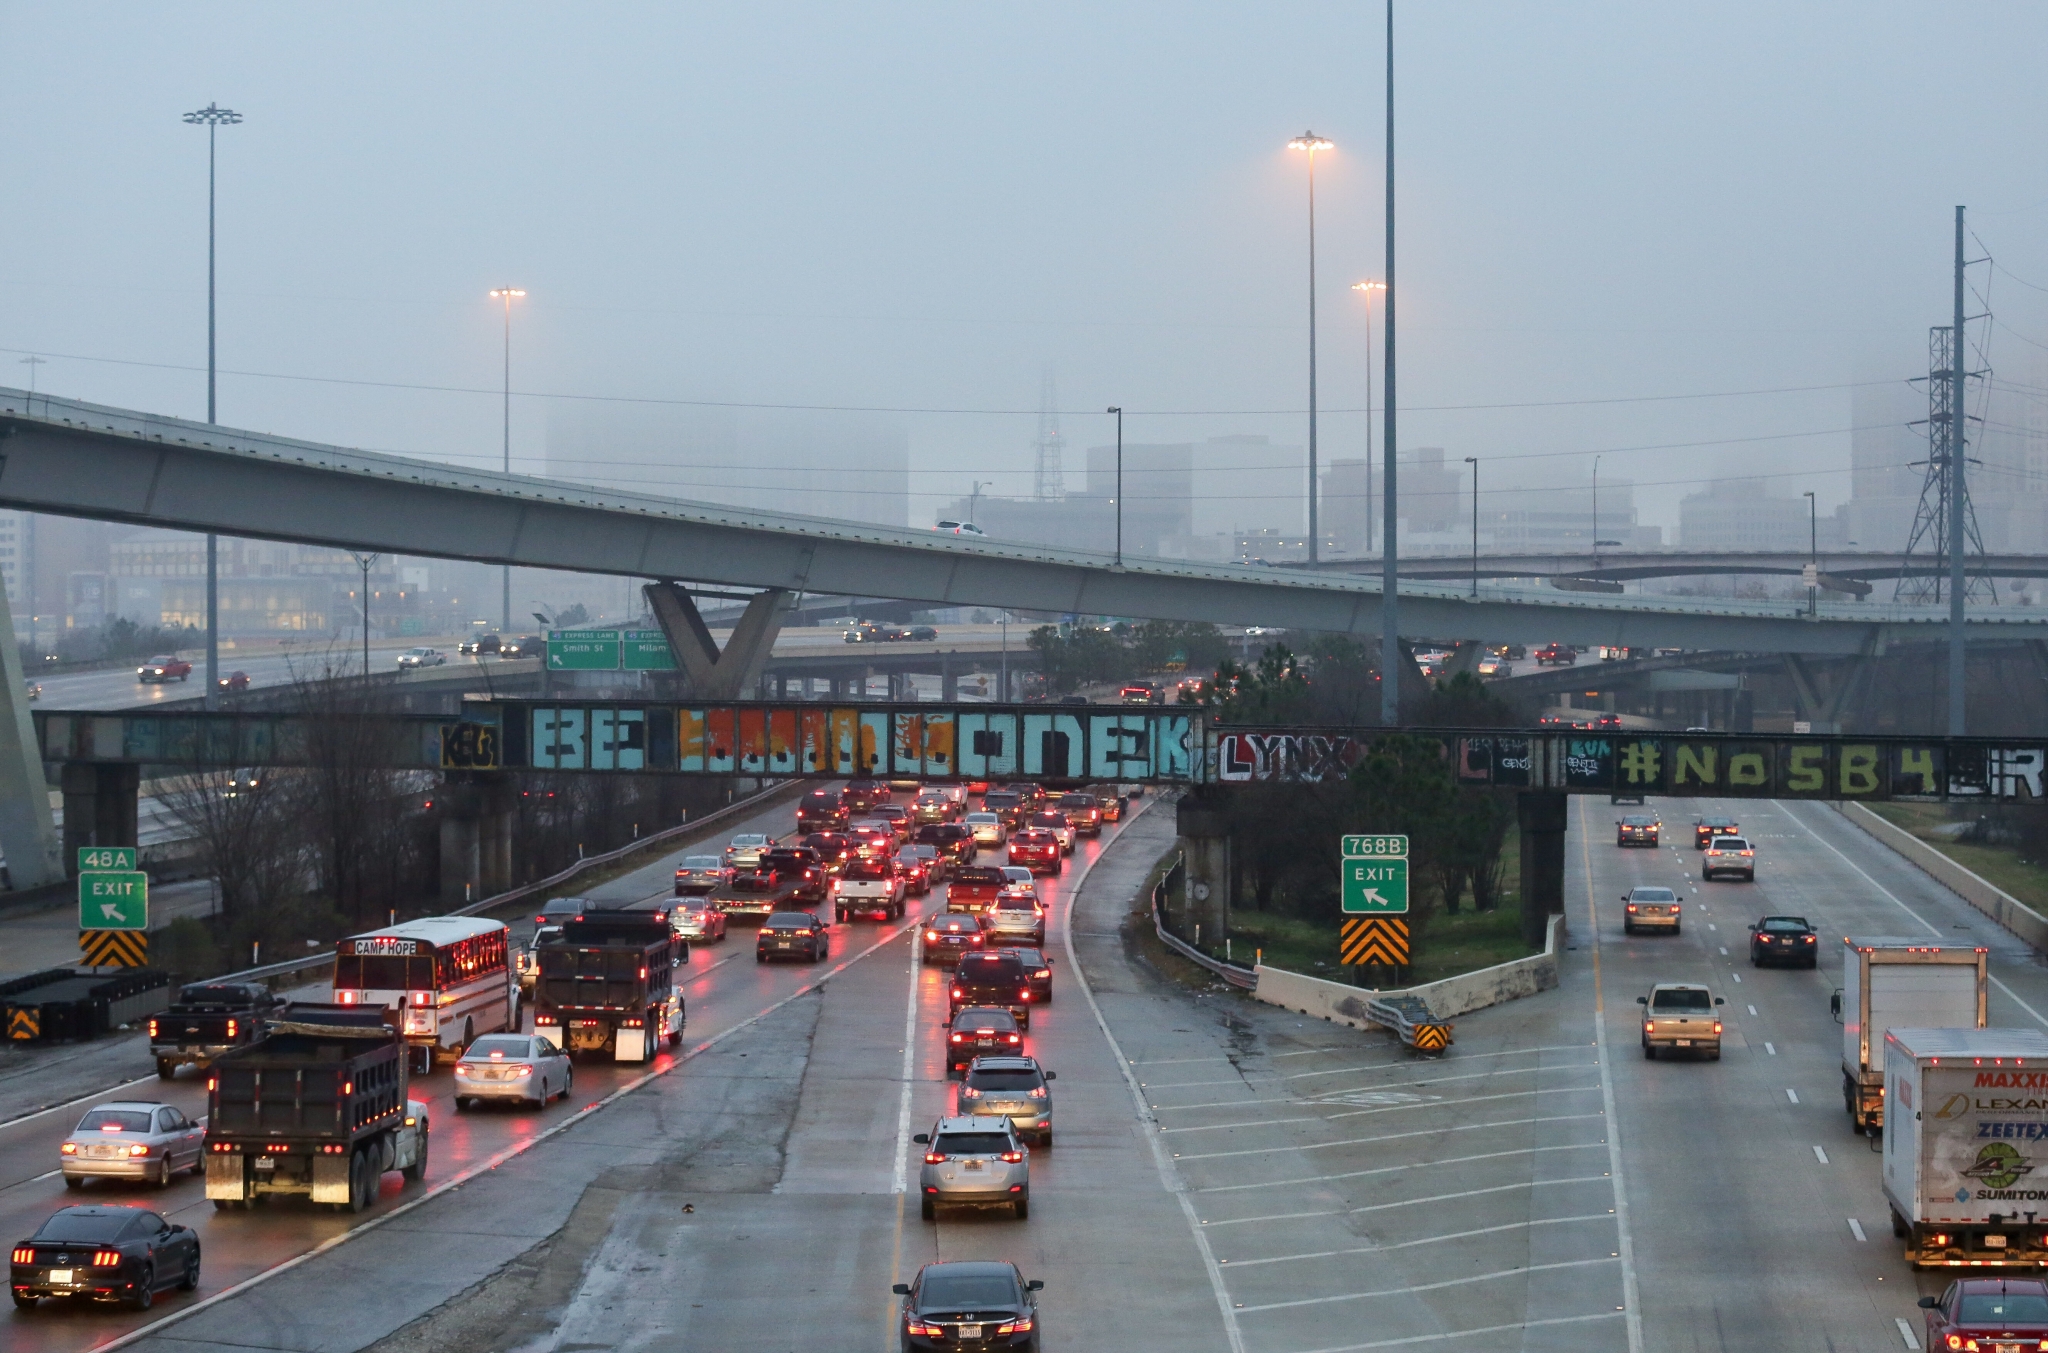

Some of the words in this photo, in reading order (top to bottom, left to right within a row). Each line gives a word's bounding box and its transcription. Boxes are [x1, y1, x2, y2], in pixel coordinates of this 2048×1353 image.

[563, 645, 590, 653] Smith
[594, 645, 604, 653] St
[533, 708, 644, 770] BE
[1350, 838, 1401, 854] 768B
[85, 851, 128, 867] 48A
[1355, 867, 1395, 880] EXIT
[93, 882, 133, 895] EXIT
[356, 941, 385, 954] CAMP
[388, 942, 416, 954] HOPE
[1915, 1111, 1922, 1121] 4
[1977, 1122, 2048, 1144] ZEETEX
